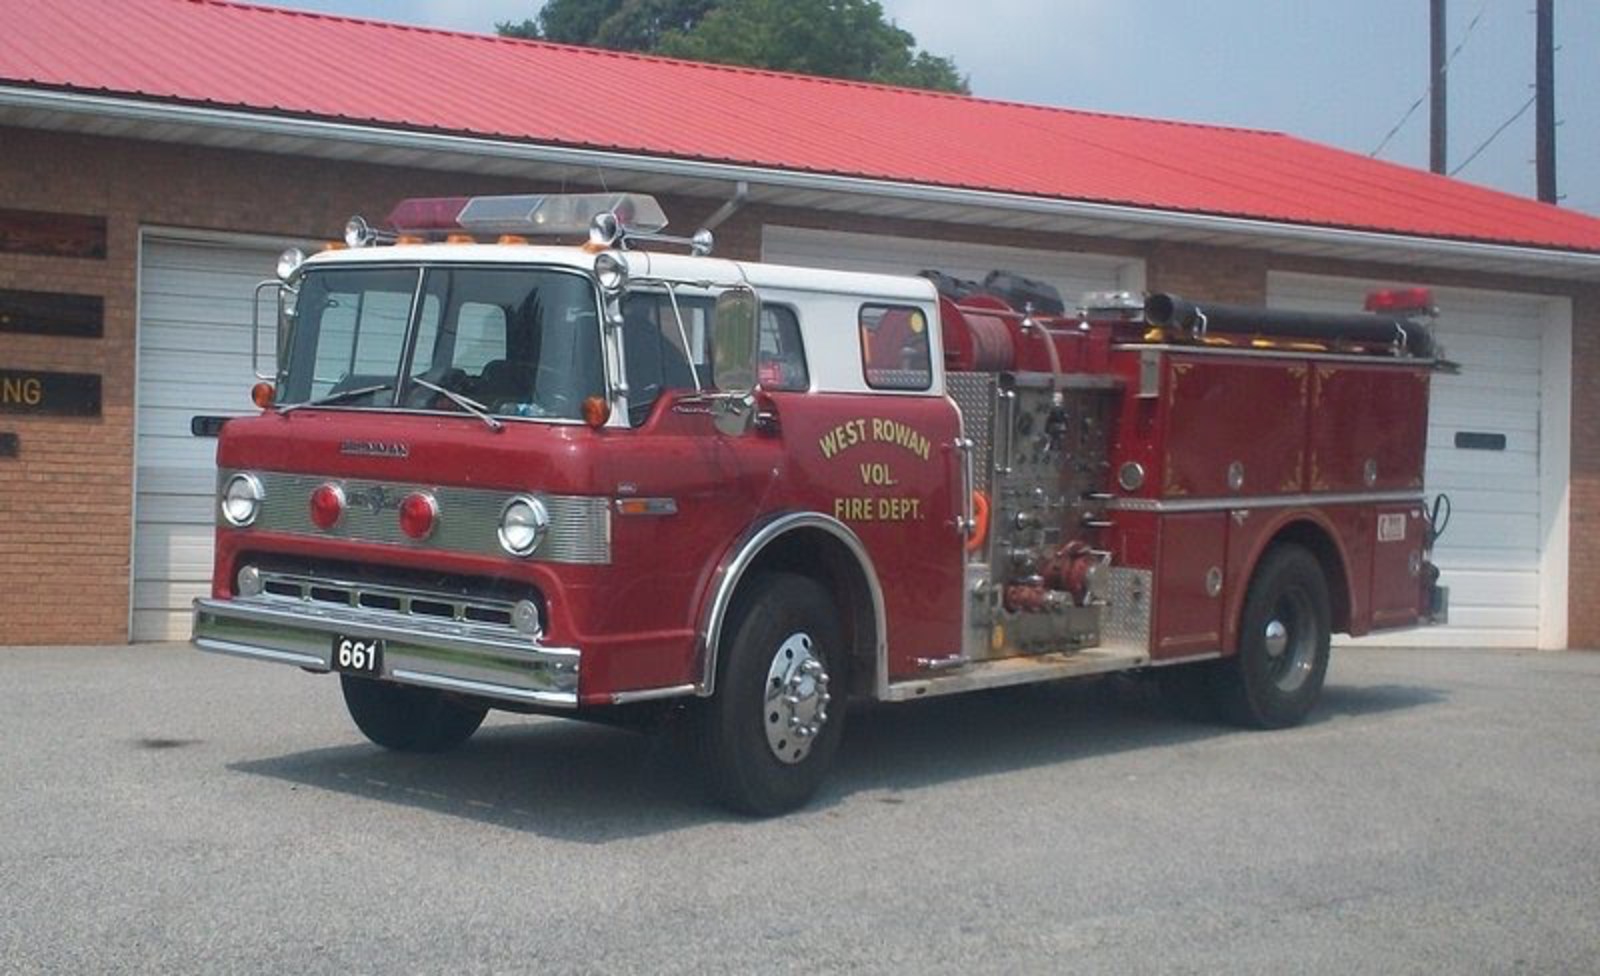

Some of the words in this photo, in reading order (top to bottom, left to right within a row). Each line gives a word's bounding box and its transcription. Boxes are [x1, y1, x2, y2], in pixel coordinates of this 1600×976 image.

[2, 377, 42, 406] NG
[819, 418, 866, 459] WEST
[872, 417, 931, 461] ROWAN
[834, 498, 873, 519] FIRE
[879, 498, 925, 519] DEPT.
[339, 639, 376, 671] 661
